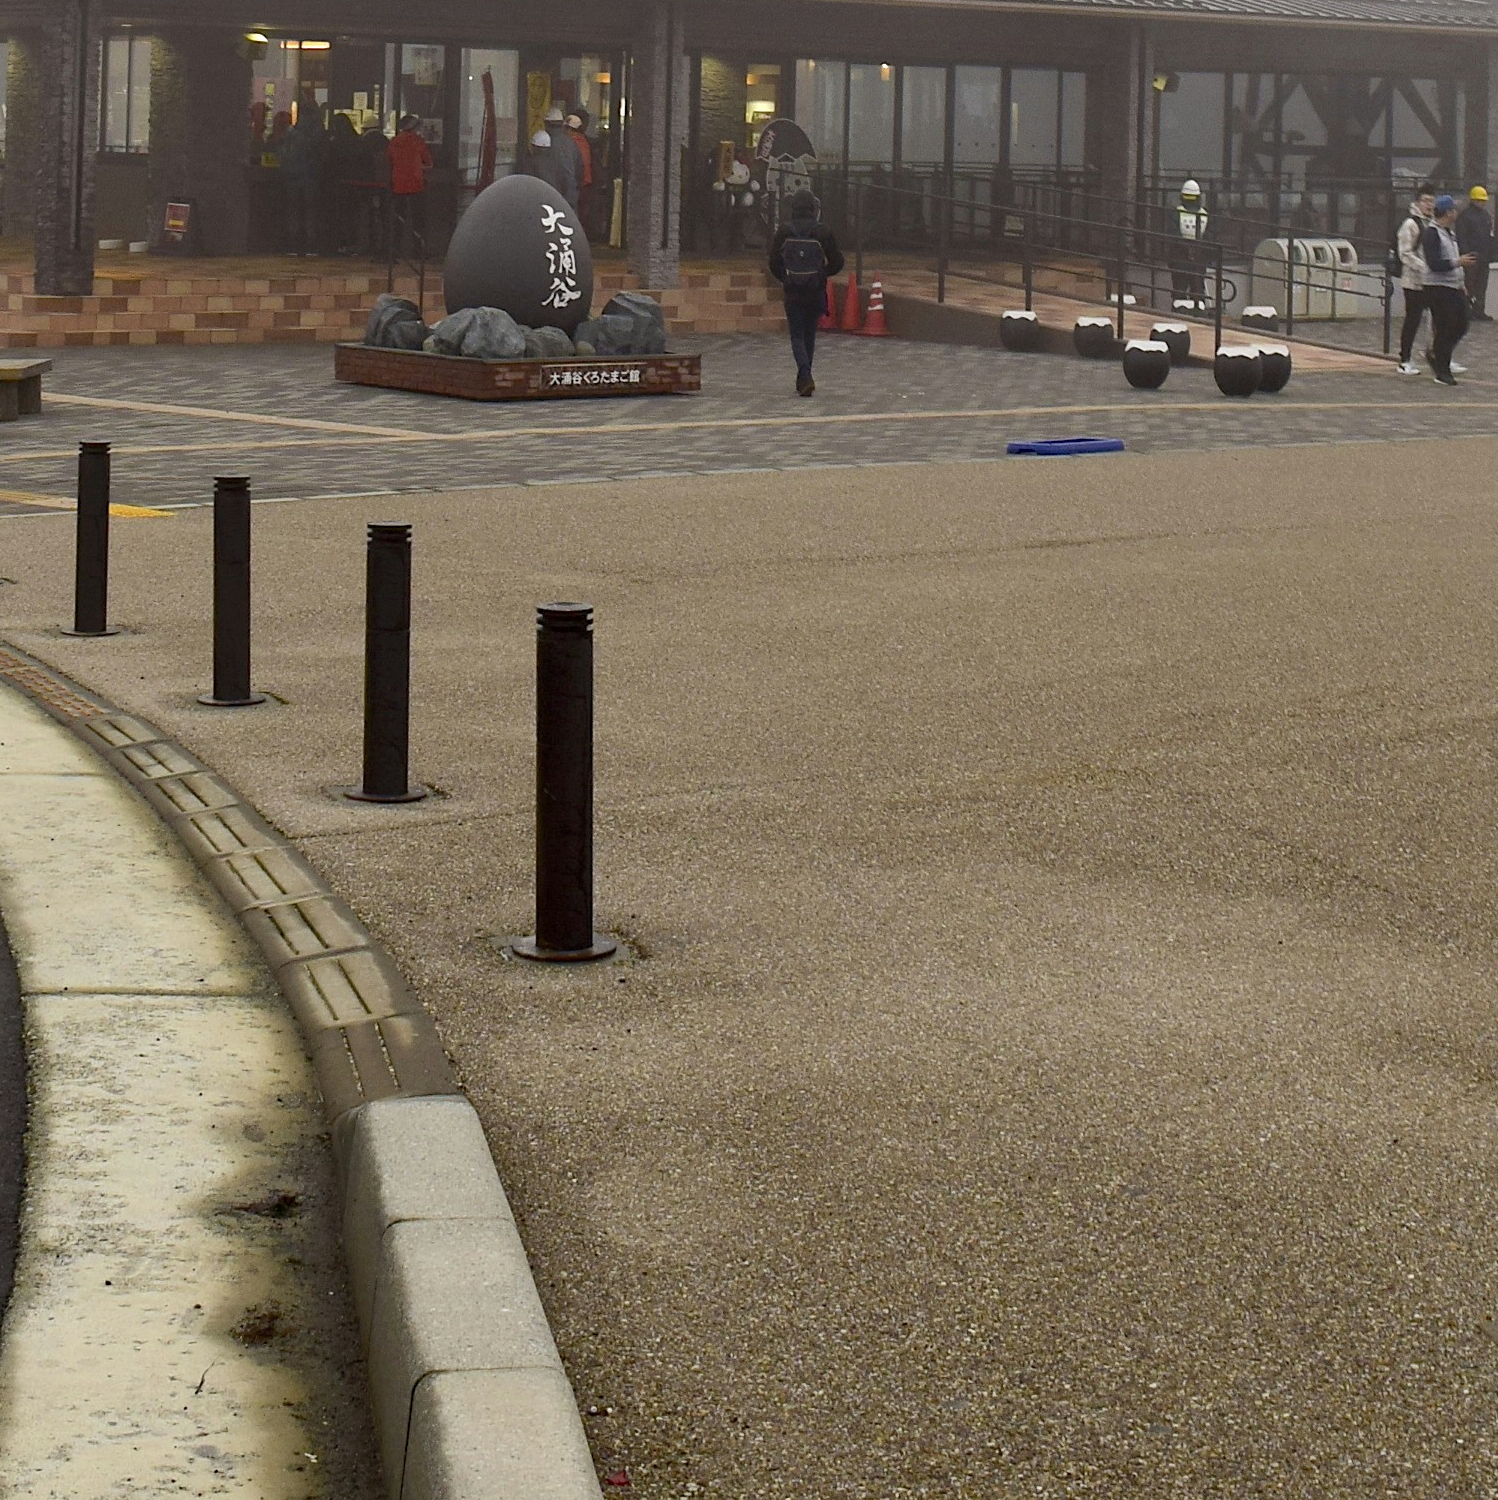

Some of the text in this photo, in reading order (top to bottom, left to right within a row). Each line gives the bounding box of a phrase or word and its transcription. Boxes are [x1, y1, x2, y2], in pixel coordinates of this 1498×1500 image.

[541, 204, 582, 309] 大涌谷
[549, 369, 641, 386] 大涌谷くろたまご館
